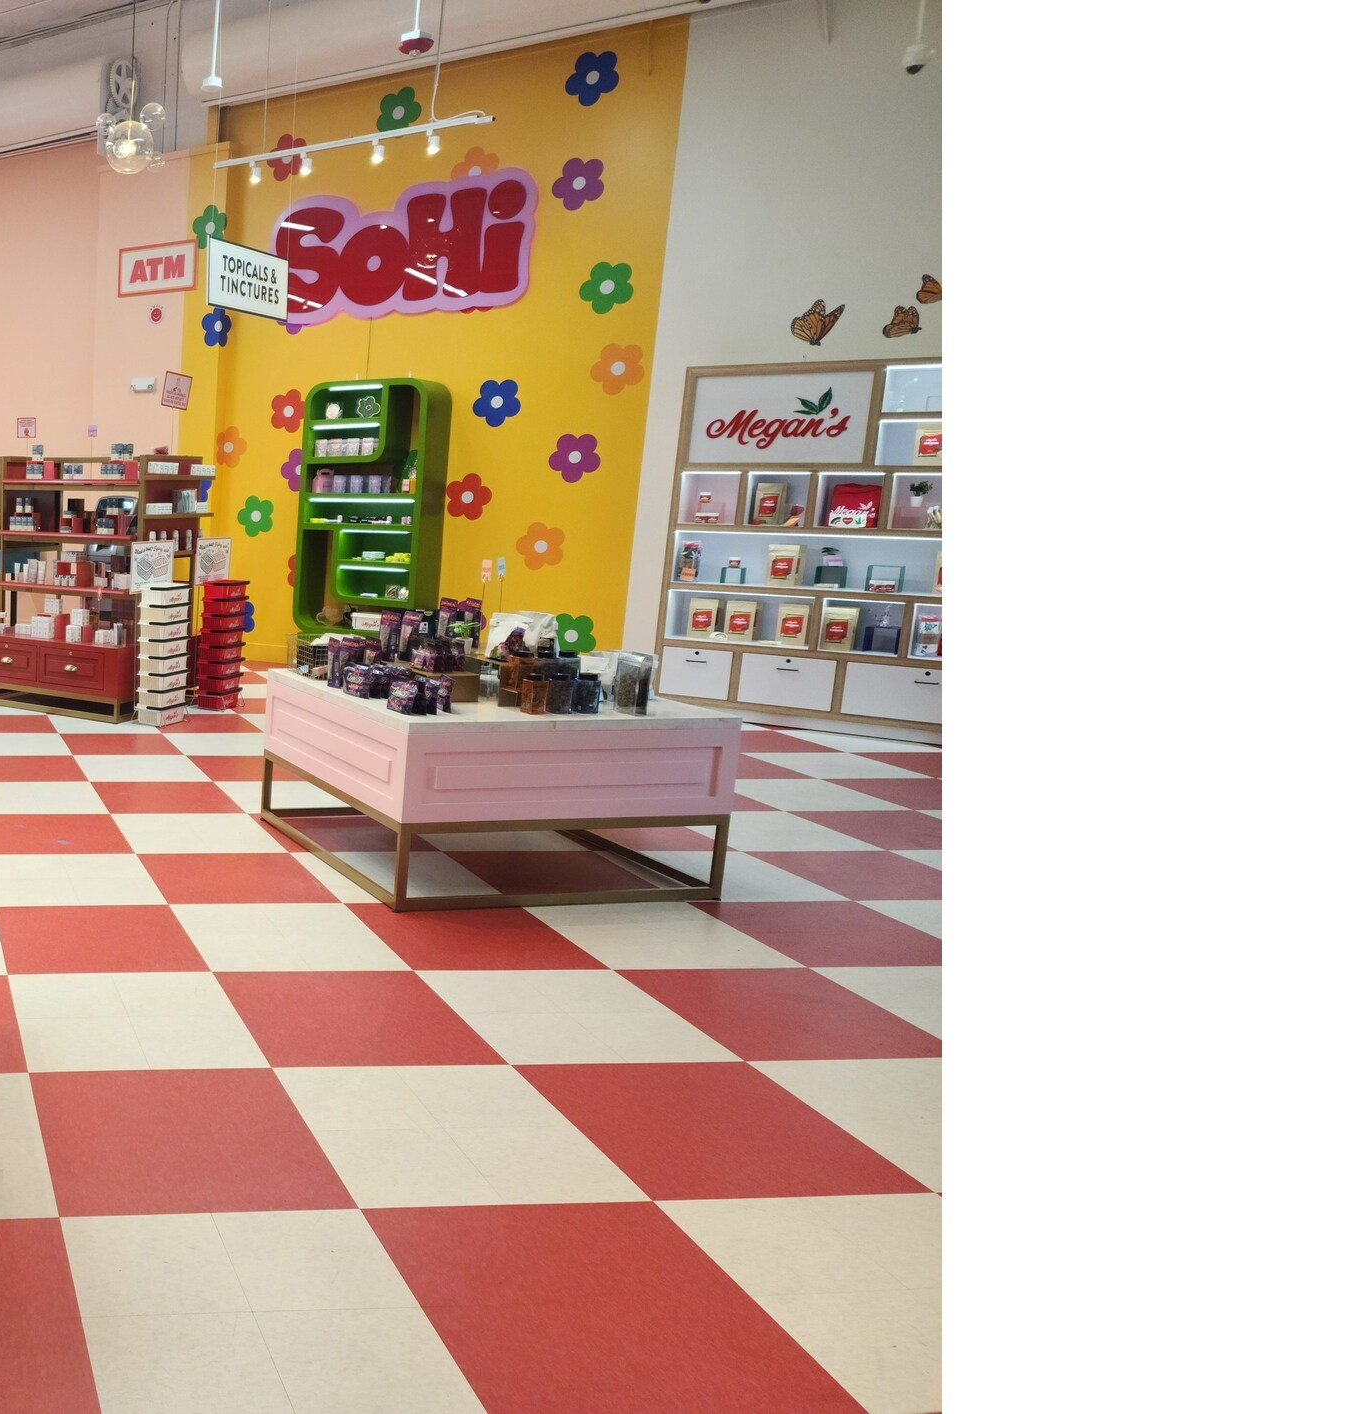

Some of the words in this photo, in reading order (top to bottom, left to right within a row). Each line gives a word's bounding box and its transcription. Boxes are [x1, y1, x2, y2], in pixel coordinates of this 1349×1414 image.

[275, 179, 526, 314] SoHi
[130, 253, 186, 284] ATM
[222, 253, 266, 284] TOPICALS
[268, 266, 277, 283] &
[220, 273, 279, 306] TINCTURES
[705, 407, 851, 450] Megan's
